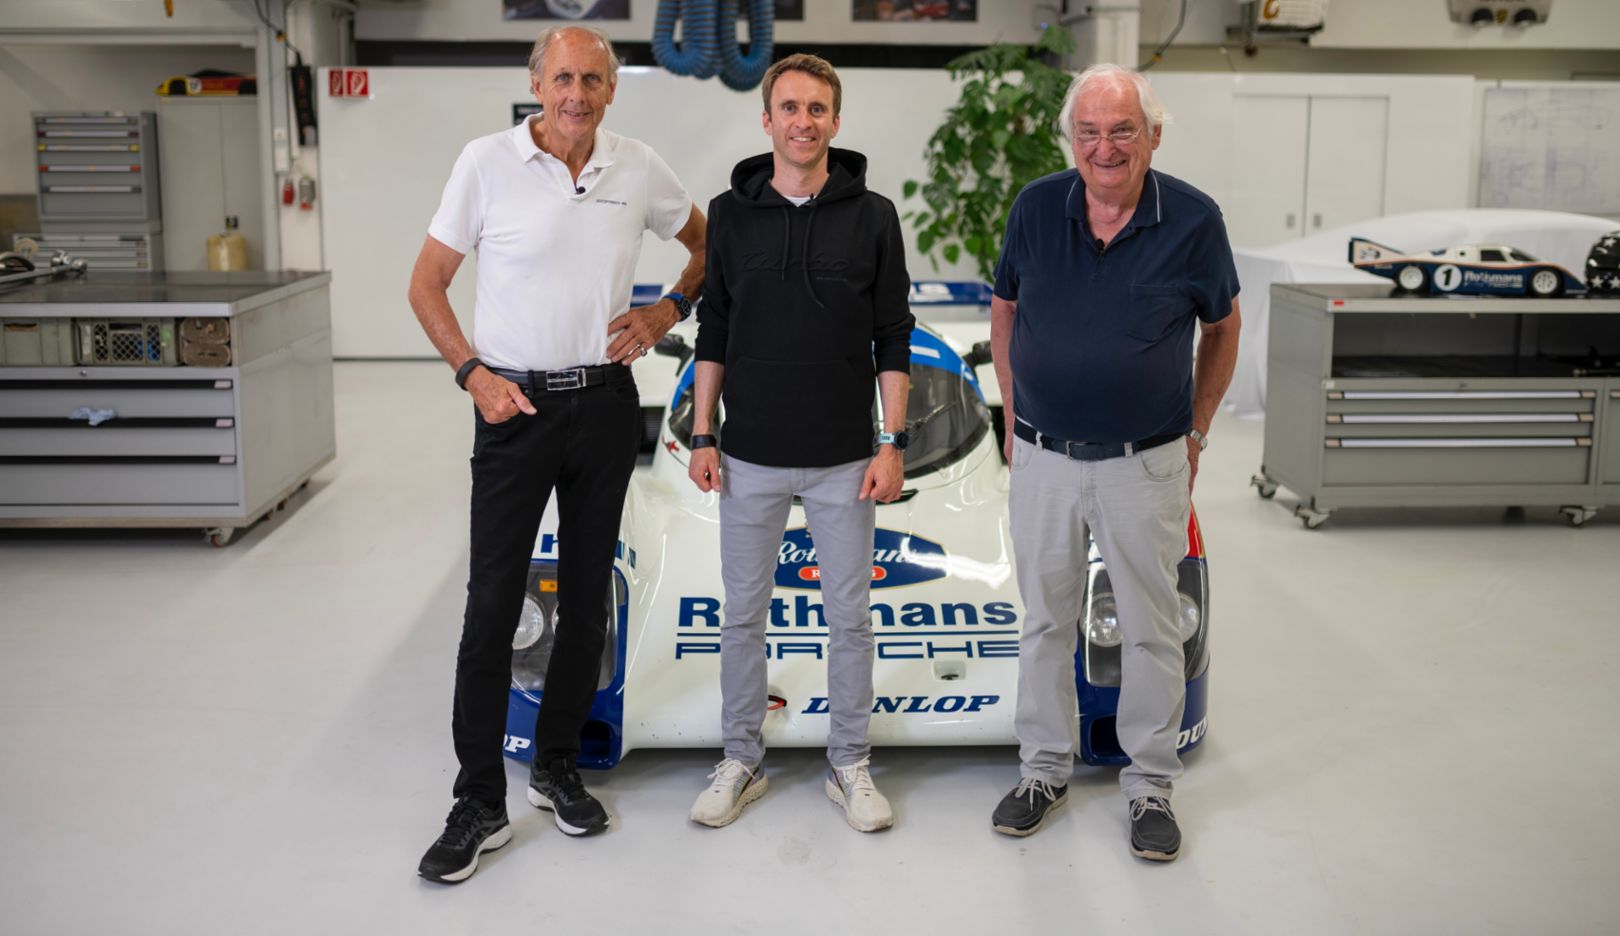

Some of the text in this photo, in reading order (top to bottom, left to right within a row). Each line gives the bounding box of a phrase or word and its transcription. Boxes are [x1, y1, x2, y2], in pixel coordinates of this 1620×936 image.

[1442, 268, 1453, 287] 1
[678, 595, 1018, 627] Rthans
[675, 640, 1020, 660] PRCHE
[801, 695, 1000, 714] DNLOP
